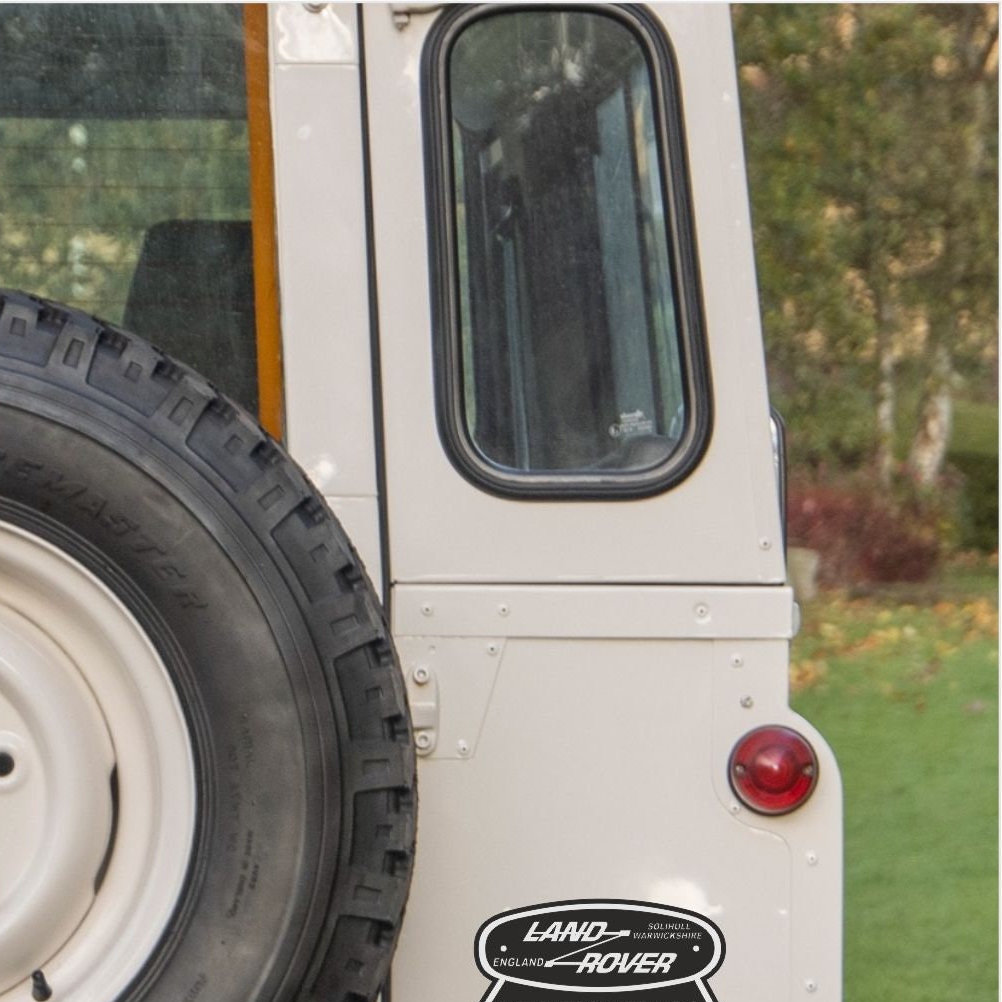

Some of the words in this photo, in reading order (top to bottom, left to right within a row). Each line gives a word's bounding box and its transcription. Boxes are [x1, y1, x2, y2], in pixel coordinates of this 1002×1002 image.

[522, 921, 608, 942] LAND
[647, 922, 691, 930] SOLIHULL
[632, 931, 703, 940] WARWICKSHIRE
[492, 957, 544, 968] ENGLAND
[575, 952, 678, 974] ROVER
